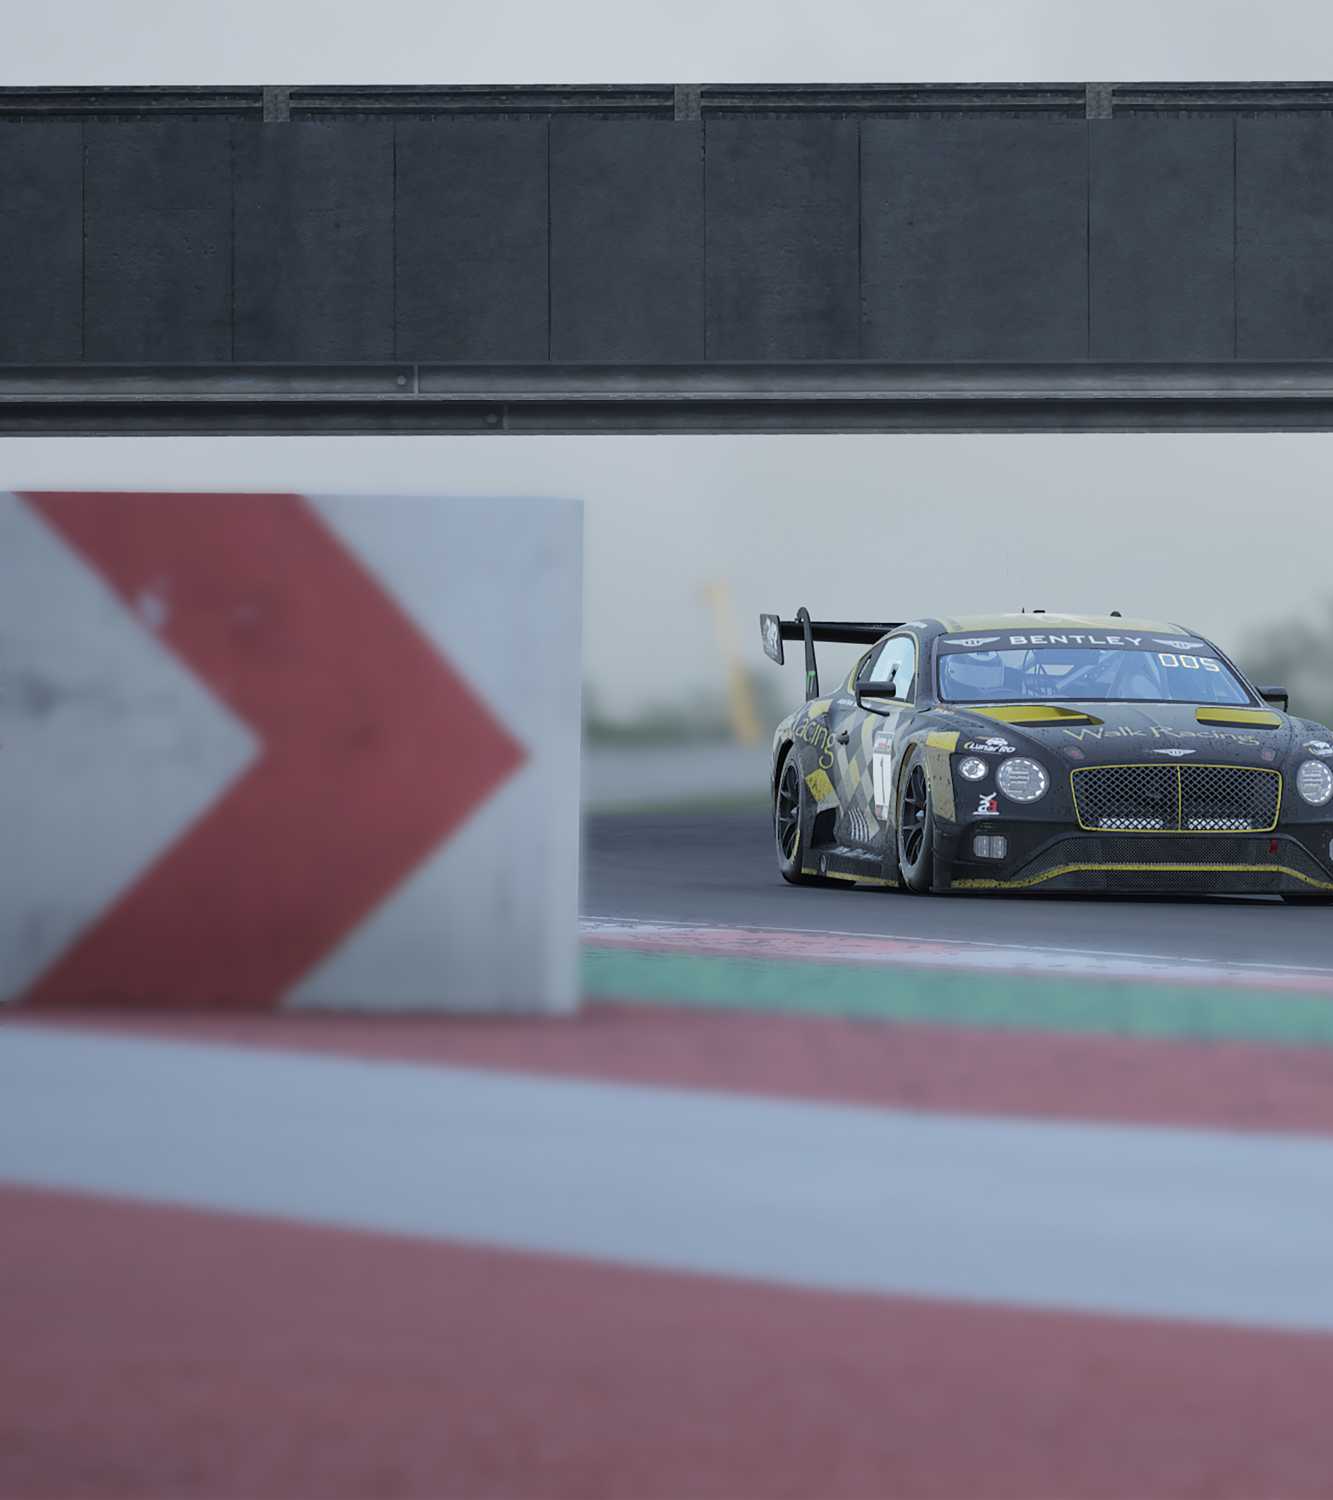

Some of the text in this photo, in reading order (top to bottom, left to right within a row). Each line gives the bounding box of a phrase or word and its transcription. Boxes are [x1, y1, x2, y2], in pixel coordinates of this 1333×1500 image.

[1009, 634, 1143, 647] BENTLEY
[1158, 653, 1221, 672] 005
[1063, 726, 1260, 746] Walk Racing
